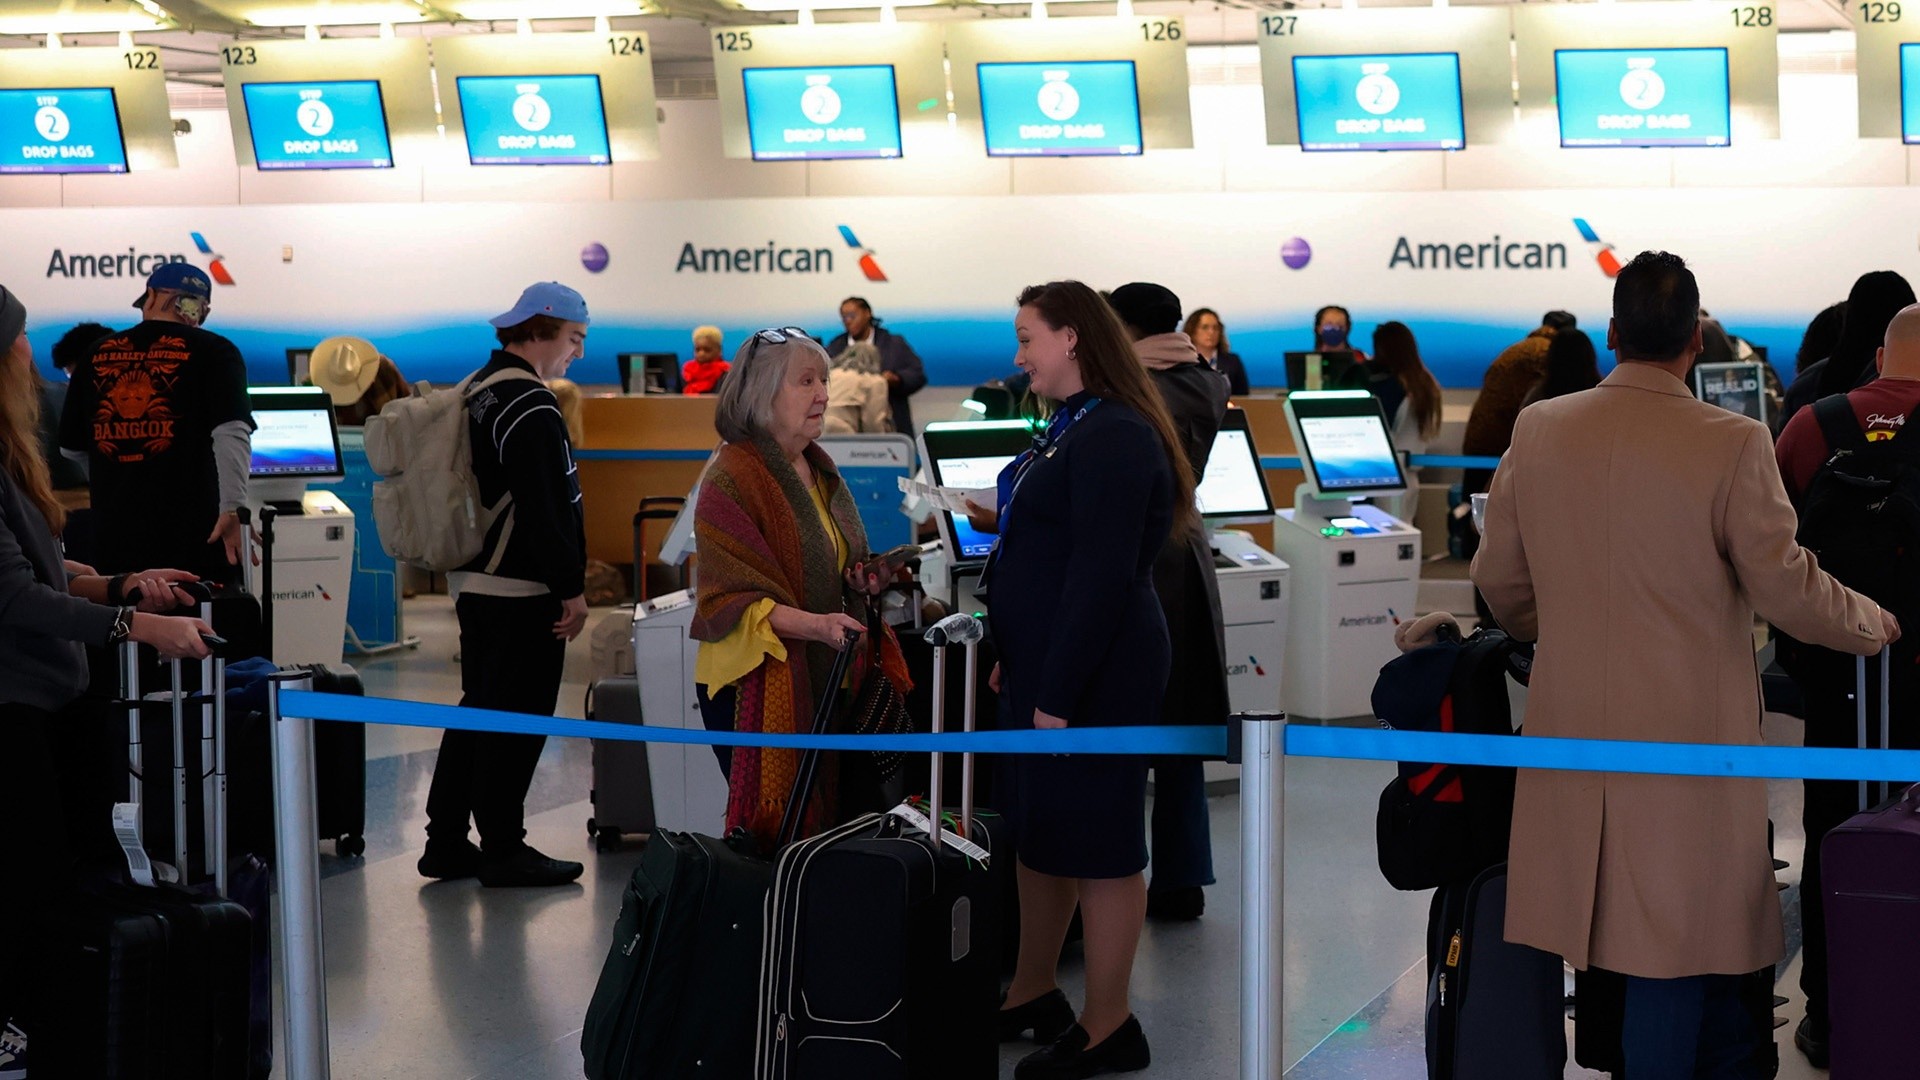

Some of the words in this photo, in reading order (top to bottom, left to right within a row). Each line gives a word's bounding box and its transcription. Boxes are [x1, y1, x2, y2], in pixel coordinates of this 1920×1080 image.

[1731, 6, 1773, 28] 128
[1860, 2, 1901, 23] 129
[1140, 22, 1181, 42] 126
[1261, 16, 1298, 36] 127
[607, 37, 645, 56] 124
[715, 32, 753, 52] 125
[124, 52, 159, 71] 122
[222, 47, 257, 66] 123
[1373, 84, 1385, 104] 2
[1634, 78, 1649, 100] 2
[36, 95, 59, 107] STEP
[815, 94, 830, 115] 2
[1054, 90, 1066, 111] 2
[308, 108, 322, 128] 2
[525, 102, 539, 122] 2
[45, 114, 60, 134] 2
[22, 145, 58, 158] DROP
[60, 145, 95, 158] BAGS
[283, 140, 320, 154] DROP
[322, 139, 359, 153] BAGS
[675, 240, 833, 274] American
[1388, 235, 1567, 271] American
[1704, 381, 1742, 395] REAL
[1743, 379, 1757, 391] ID
[271, 589, 315, 600] merican
[1338, 614, 1387, 628] American
